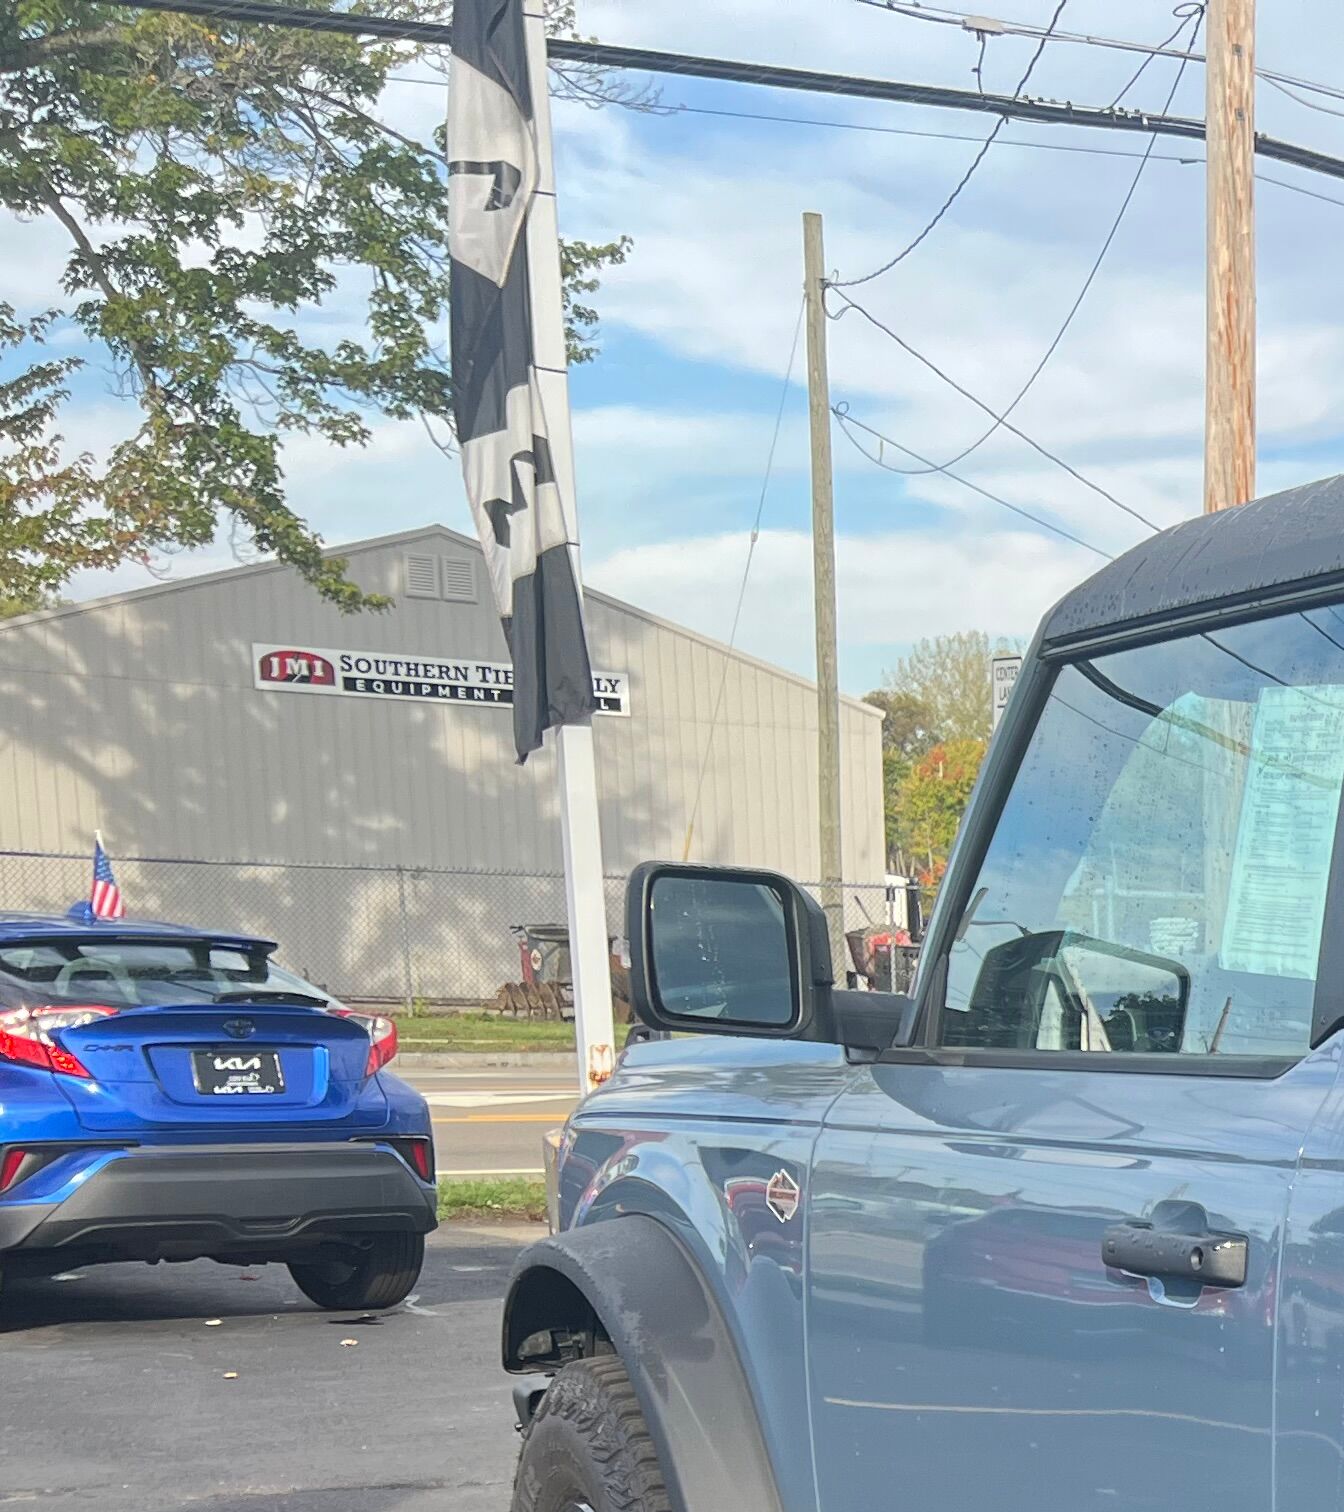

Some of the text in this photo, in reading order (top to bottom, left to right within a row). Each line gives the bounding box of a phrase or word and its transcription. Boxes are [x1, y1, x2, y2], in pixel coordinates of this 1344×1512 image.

[268, 655, 324, 678] JMI
[339, 654, 513, 686] SOUTHERN TIE
[355, 679, 502, 701] EQUIPMENT
